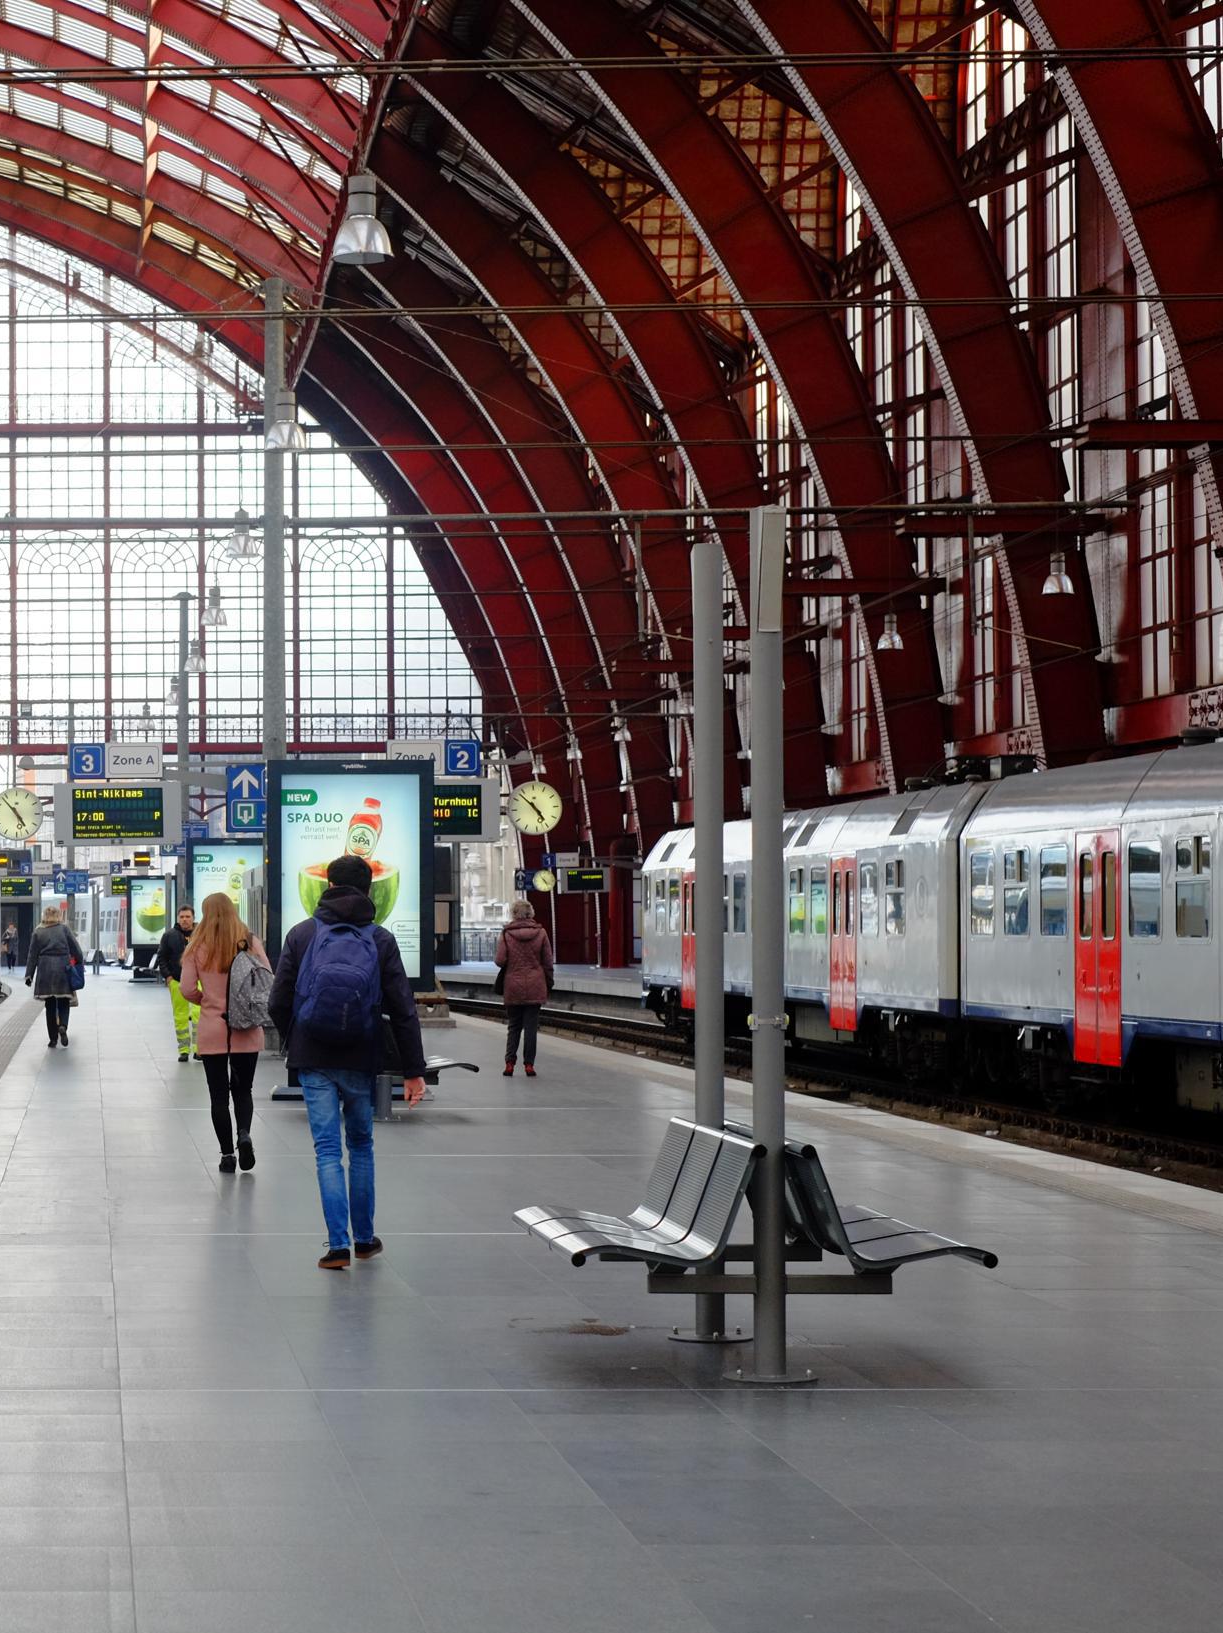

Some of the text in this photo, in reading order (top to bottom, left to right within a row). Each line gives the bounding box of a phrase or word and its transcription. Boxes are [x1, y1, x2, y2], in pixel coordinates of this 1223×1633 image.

[81, 754, 94, 772] 3
[112, 755, 155, 766] Zone A
[456, 750, 469, 769] 2
[75, 788, 144, 798] Sint-Niklaas
[286, 793, 311, 802] NEW
[434, 797, 478, 806] Turnhout
[76, 811, 160, 822] 17:00 P
[468, 808, 478, 817] IC
[286, 813, 344, 823] SPA DUO
[352, 835, 370, 846] SPA
[113, 864, 119, 872] 2
